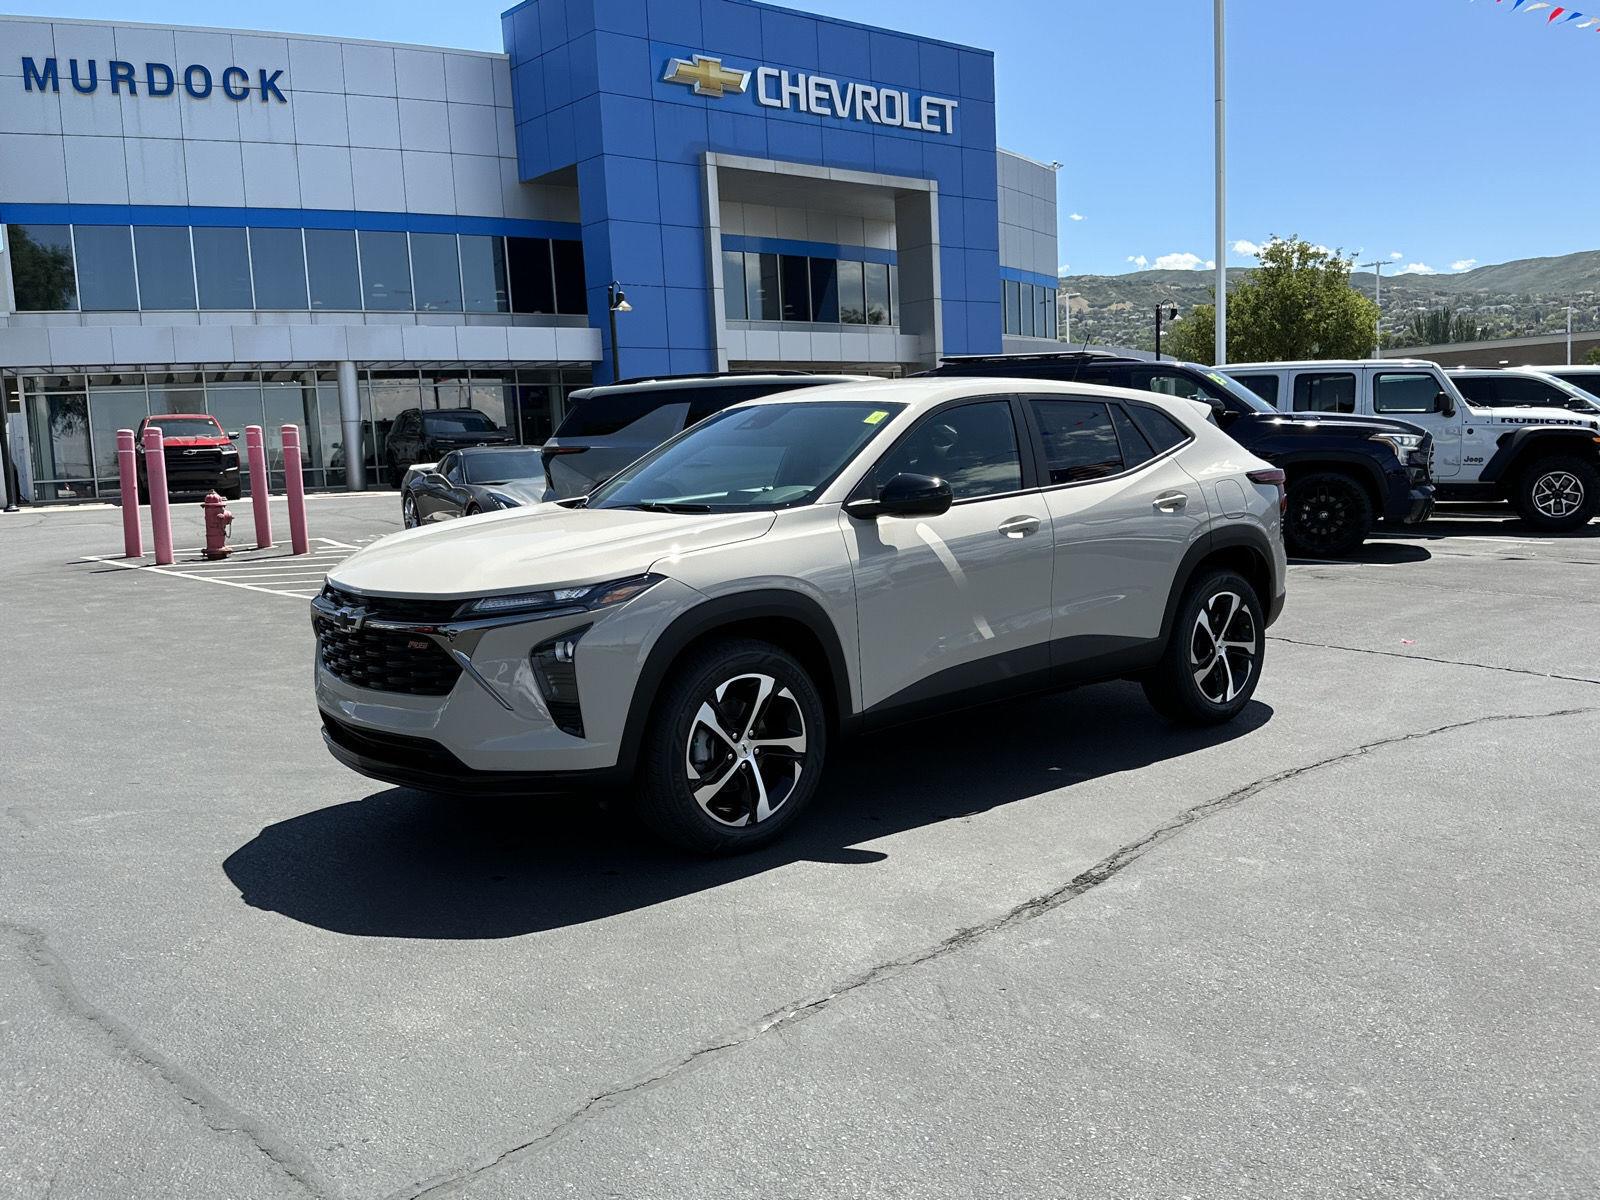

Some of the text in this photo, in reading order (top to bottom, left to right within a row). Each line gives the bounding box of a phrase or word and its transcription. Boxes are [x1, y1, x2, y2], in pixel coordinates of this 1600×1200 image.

[21, 56, 288, 104] MURDOCK
[757, 66, 958, 134] CHEVROLET
[1501, 417, 1582, 425] RUBICON
[1463, 455, 1484, 463] Jeep
